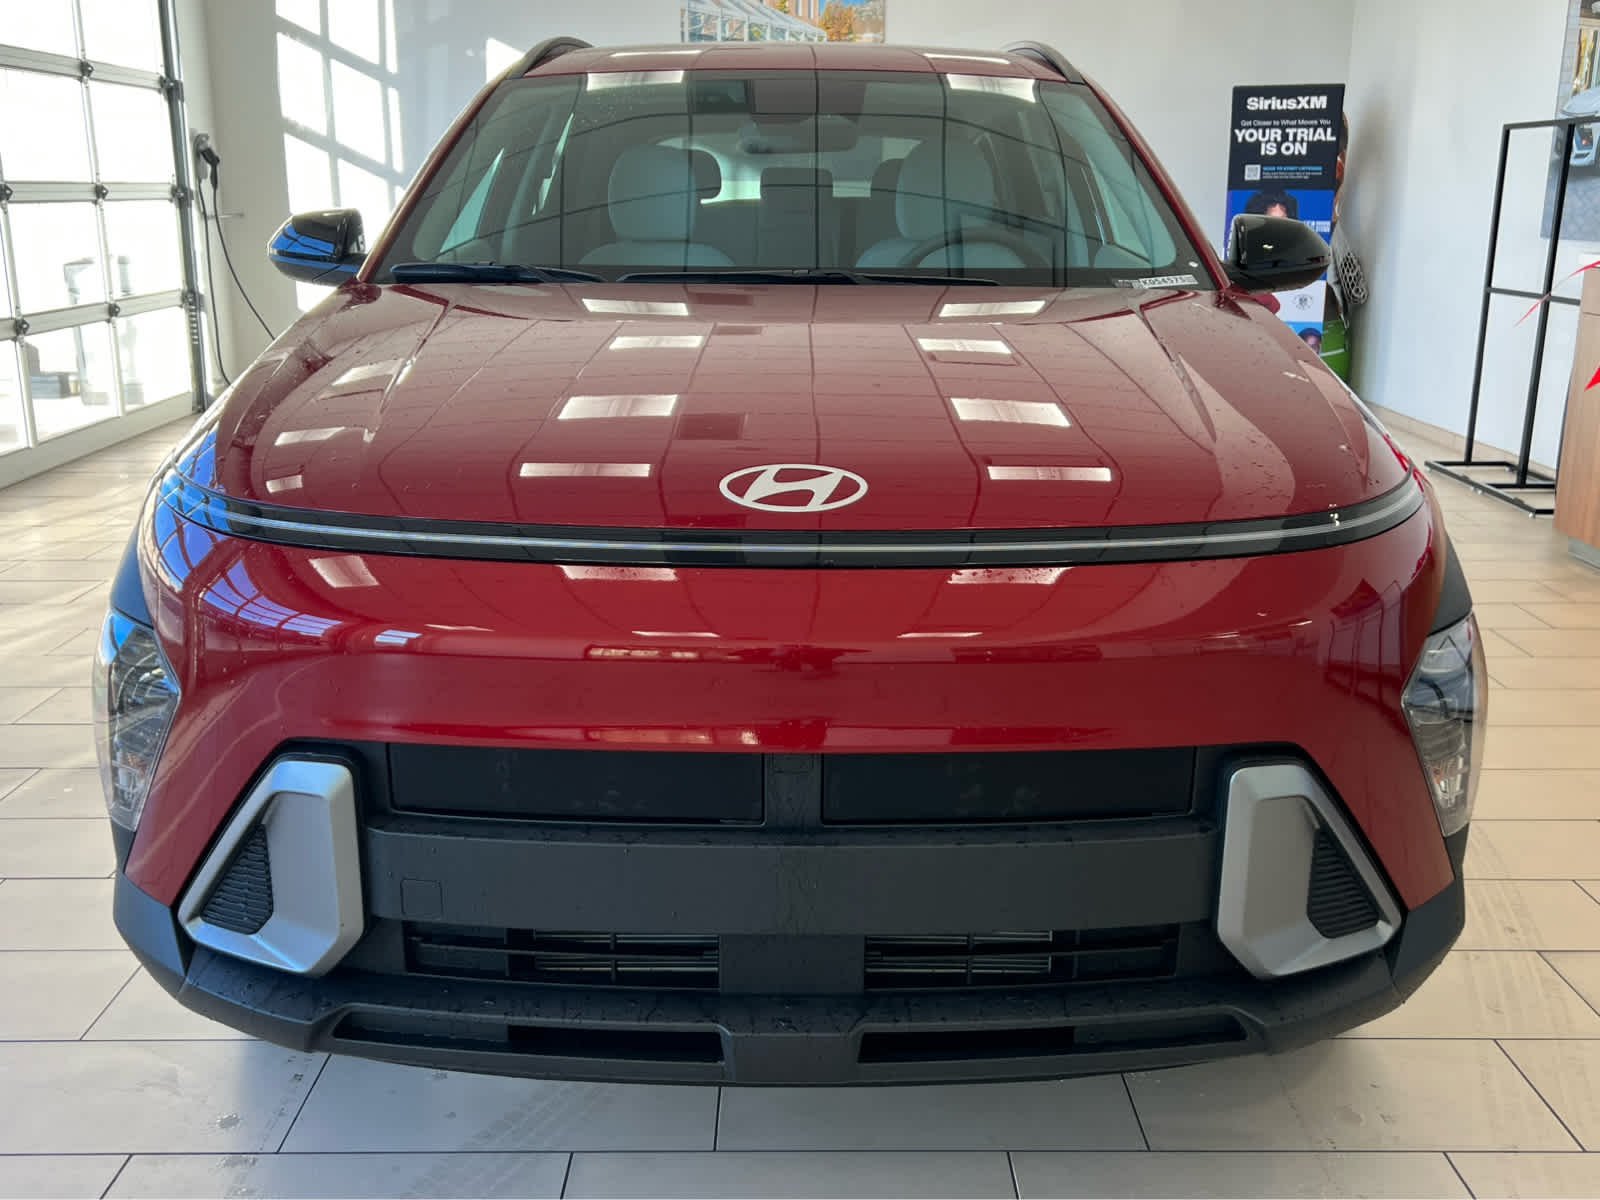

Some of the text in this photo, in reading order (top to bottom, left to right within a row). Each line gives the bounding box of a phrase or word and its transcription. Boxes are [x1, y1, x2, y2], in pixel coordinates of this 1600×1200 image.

[1246, 96, 1327, 110] SiriusXM
[1234, 127, 1336, 142] YOUR TRIAL
[1260, 142, 1307, 155] IS ON
